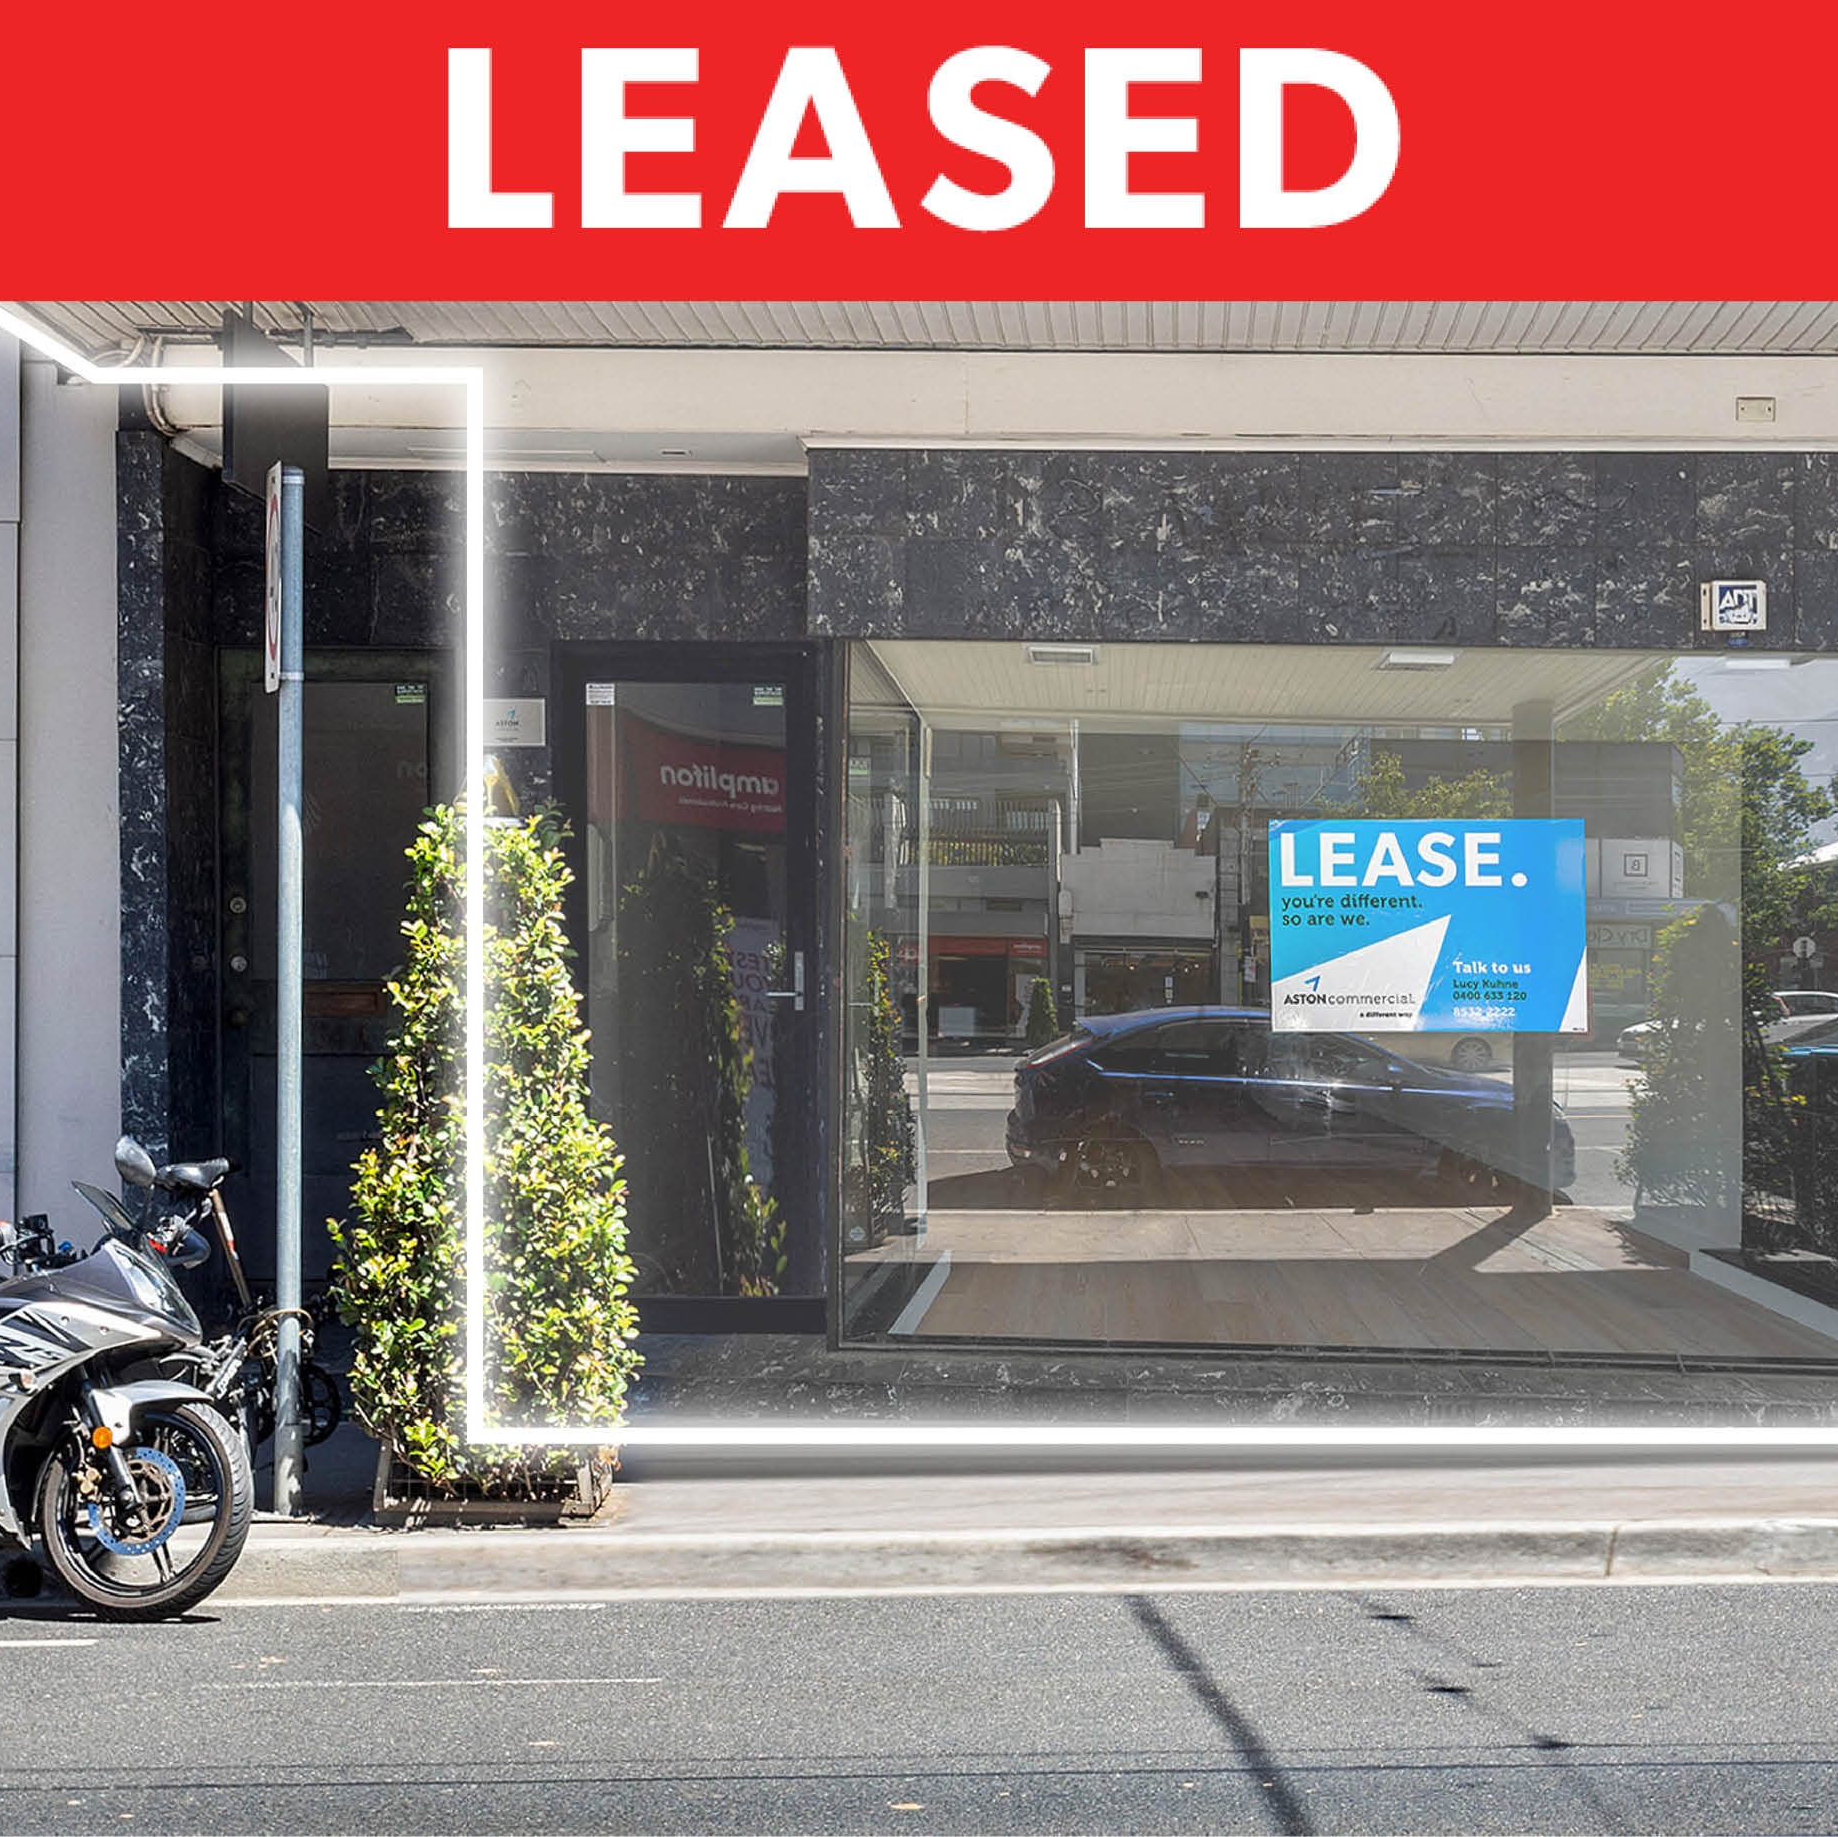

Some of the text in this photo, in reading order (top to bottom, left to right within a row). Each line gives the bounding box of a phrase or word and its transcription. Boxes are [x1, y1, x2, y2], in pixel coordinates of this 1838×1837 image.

[1718, 588, 1758, 610] ADT
[1280, 832, 1528, 887] LEASE.
[1281, 893, 1423, 912] you're different.
[1282, 913, 1370, 926] so are we.
[1452, 961, 1531, 974] Talk to us
[1452, 979, 1479, 992] Lucy
[1283, 993, 1416, 1005] ASTON commercial
[1452, 990, 1481, 1001] 0400
[1506, 990, 1528, 1001] 120
